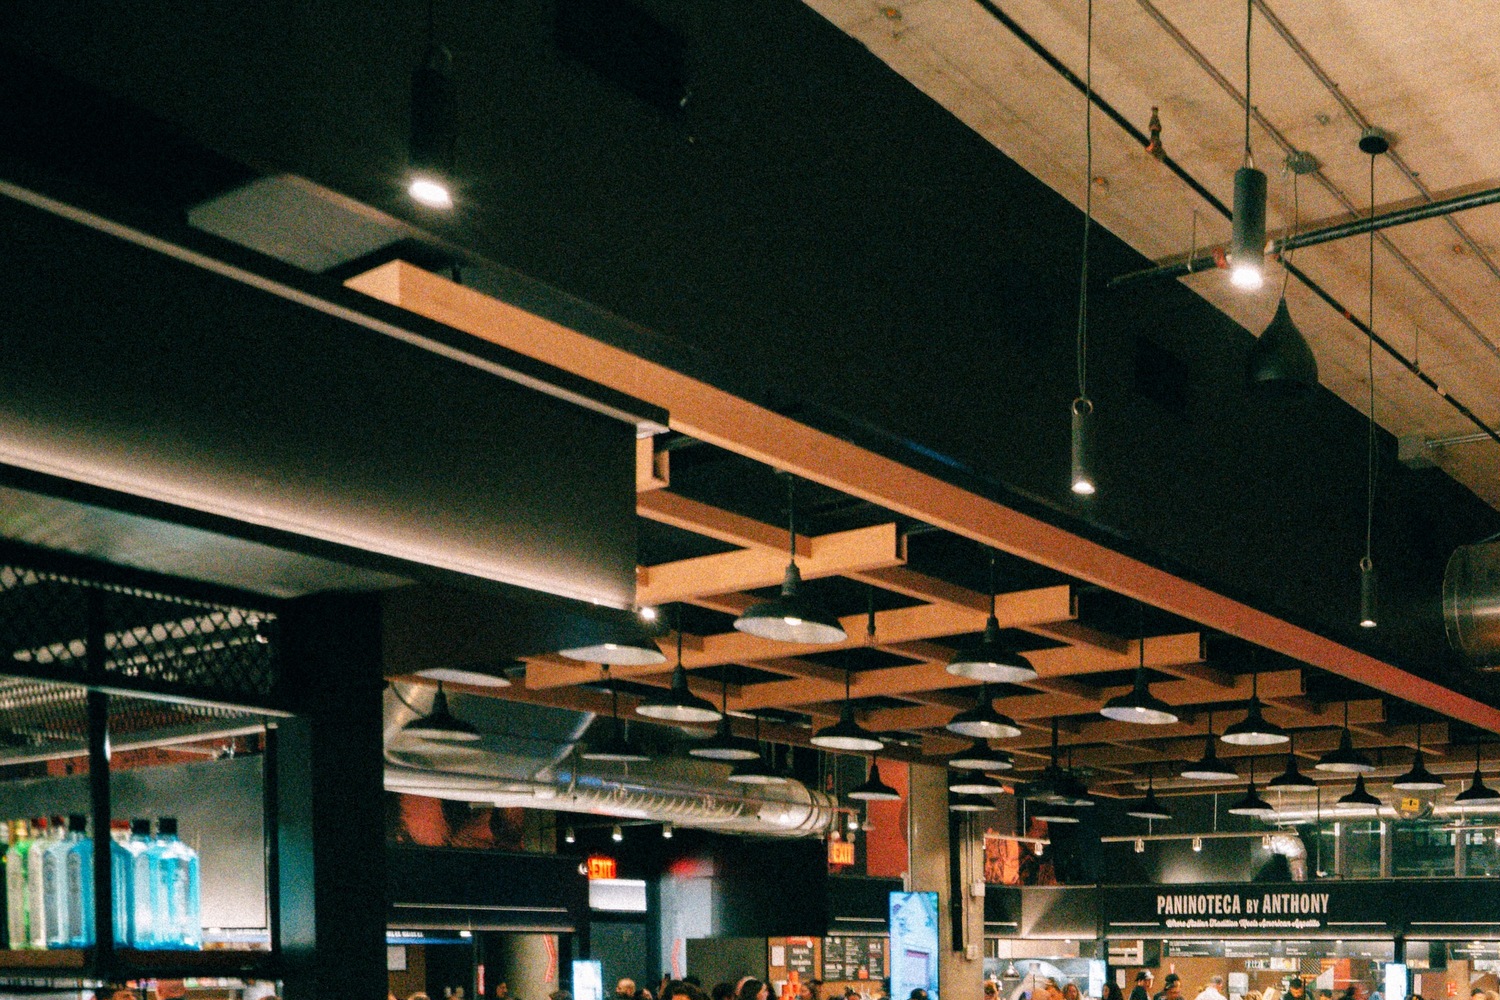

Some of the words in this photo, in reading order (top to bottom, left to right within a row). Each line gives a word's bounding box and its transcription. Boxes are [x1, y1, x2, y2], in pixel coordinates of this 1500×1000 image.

[591, 859, 612, 879] EXIT
[1157, 895, 1241, 914] PANINOTECA
[1246, 899, 1259, 914] BY
[1262, 894, 1329, 914] ANTHONY
